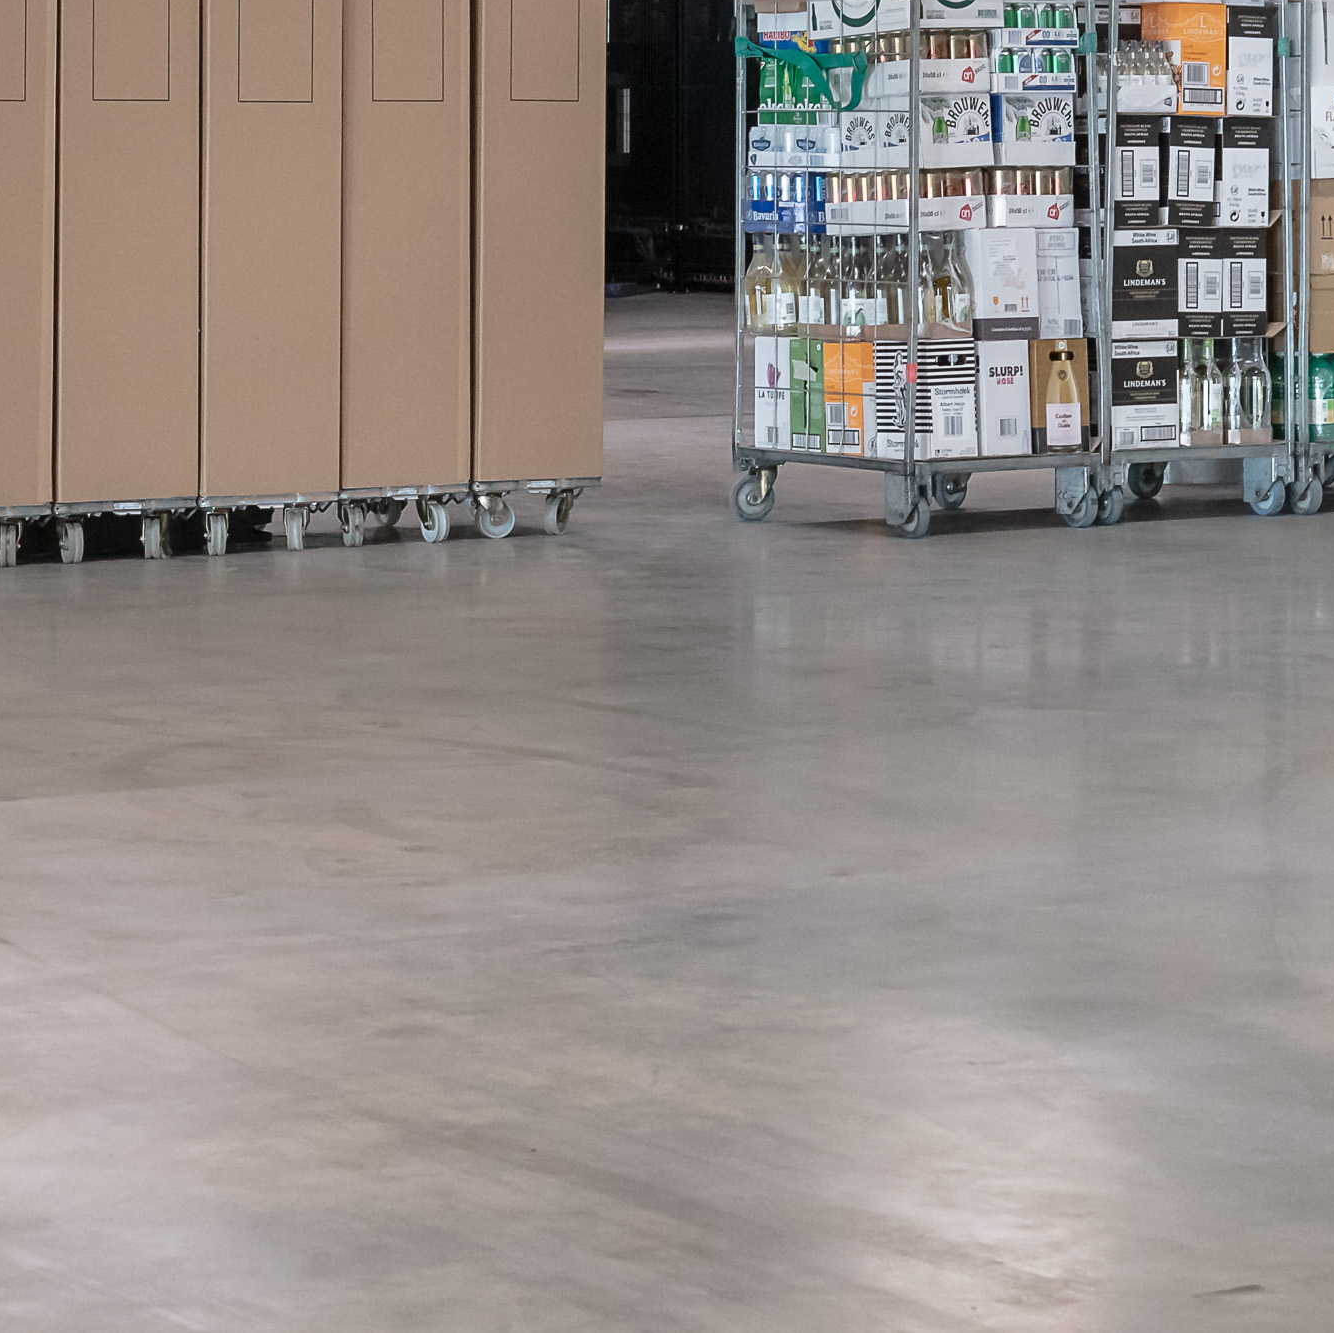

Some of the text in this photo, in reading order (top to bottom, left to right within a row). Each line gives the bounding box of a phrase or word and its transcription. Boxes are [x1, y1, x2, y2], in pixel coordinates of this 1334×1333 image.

[763, 32, 791, 40] HAIBO
[845, 116, 875, 142] BROUWERS
[884, 112, 910, 138] BROUWE
[1123, 278, 1166, 286] LINDEMAN'S
[989, 366, 1023, 378] SLURP!
[1123, 379, 1166, 388] LINDEMAN'S
[767, 391, 785, 400] TUIPE
[934, 387, 970, 395] Stormhoek
[887, 439, 919, 448] Stormk
